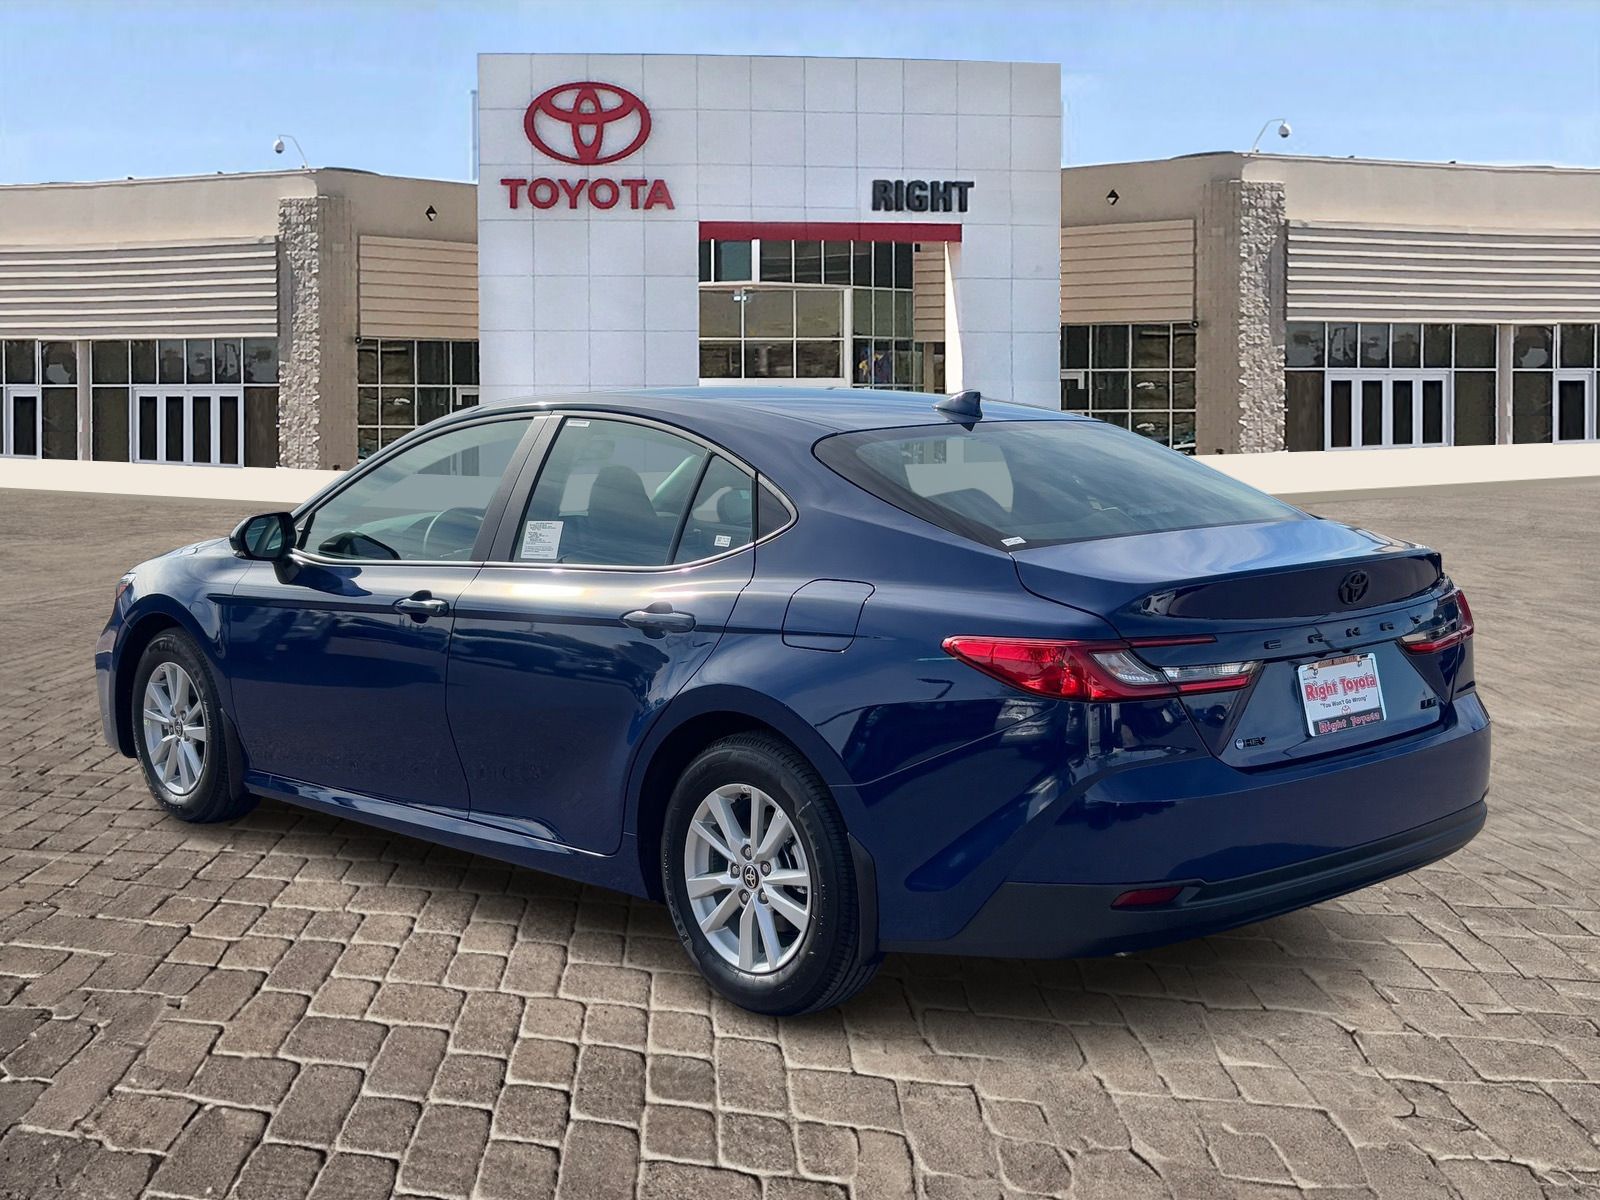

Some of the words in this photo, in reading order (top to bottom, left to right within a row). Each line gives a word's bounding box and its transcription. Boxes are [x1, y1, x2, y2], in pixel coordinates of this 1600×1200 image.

[500, 177, 675, 210] TOYOTA
[871, 179, 975, 213] RIGHT
[1304, 680, 1338, 702] Right
[1340, 673, 1377, 696] Toyota
[1318, 719, 1347, 734] Right
[1350, 712, 1380, 727] Toyota
